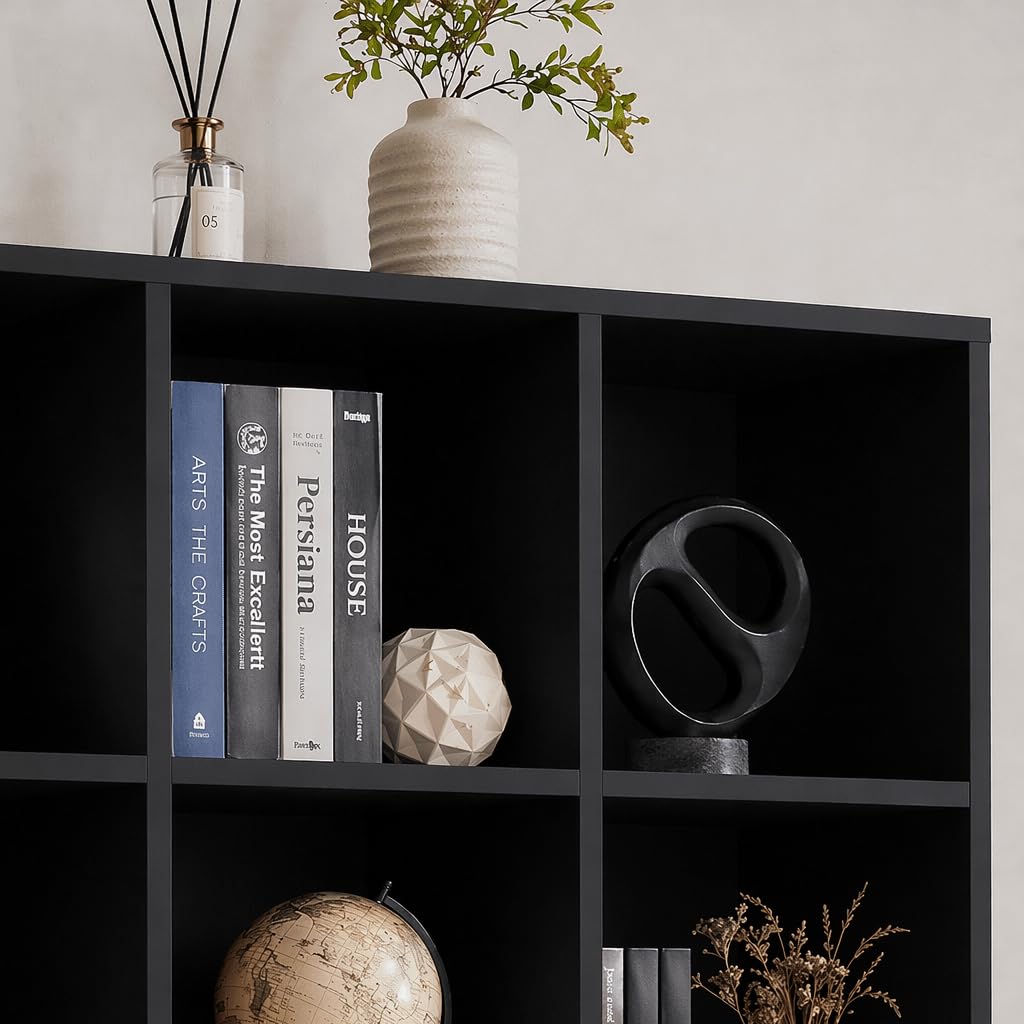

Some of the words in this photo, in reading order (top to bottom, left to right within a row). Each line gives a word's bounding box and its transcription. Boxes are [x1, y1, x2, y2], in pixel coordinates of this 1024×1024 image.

[201, 214, 218, 229] 05
[191, 455, 207, 511] ARTS
[249, 465, 266, 505] The
[191, 525, 207, 564] THE
[249, 511, 266, 563] Most
[296, 475, 321, 615] Persiana
[347, 512, 367, 616] HOUSE
[191, 575, 207, 653] CRAFTS
